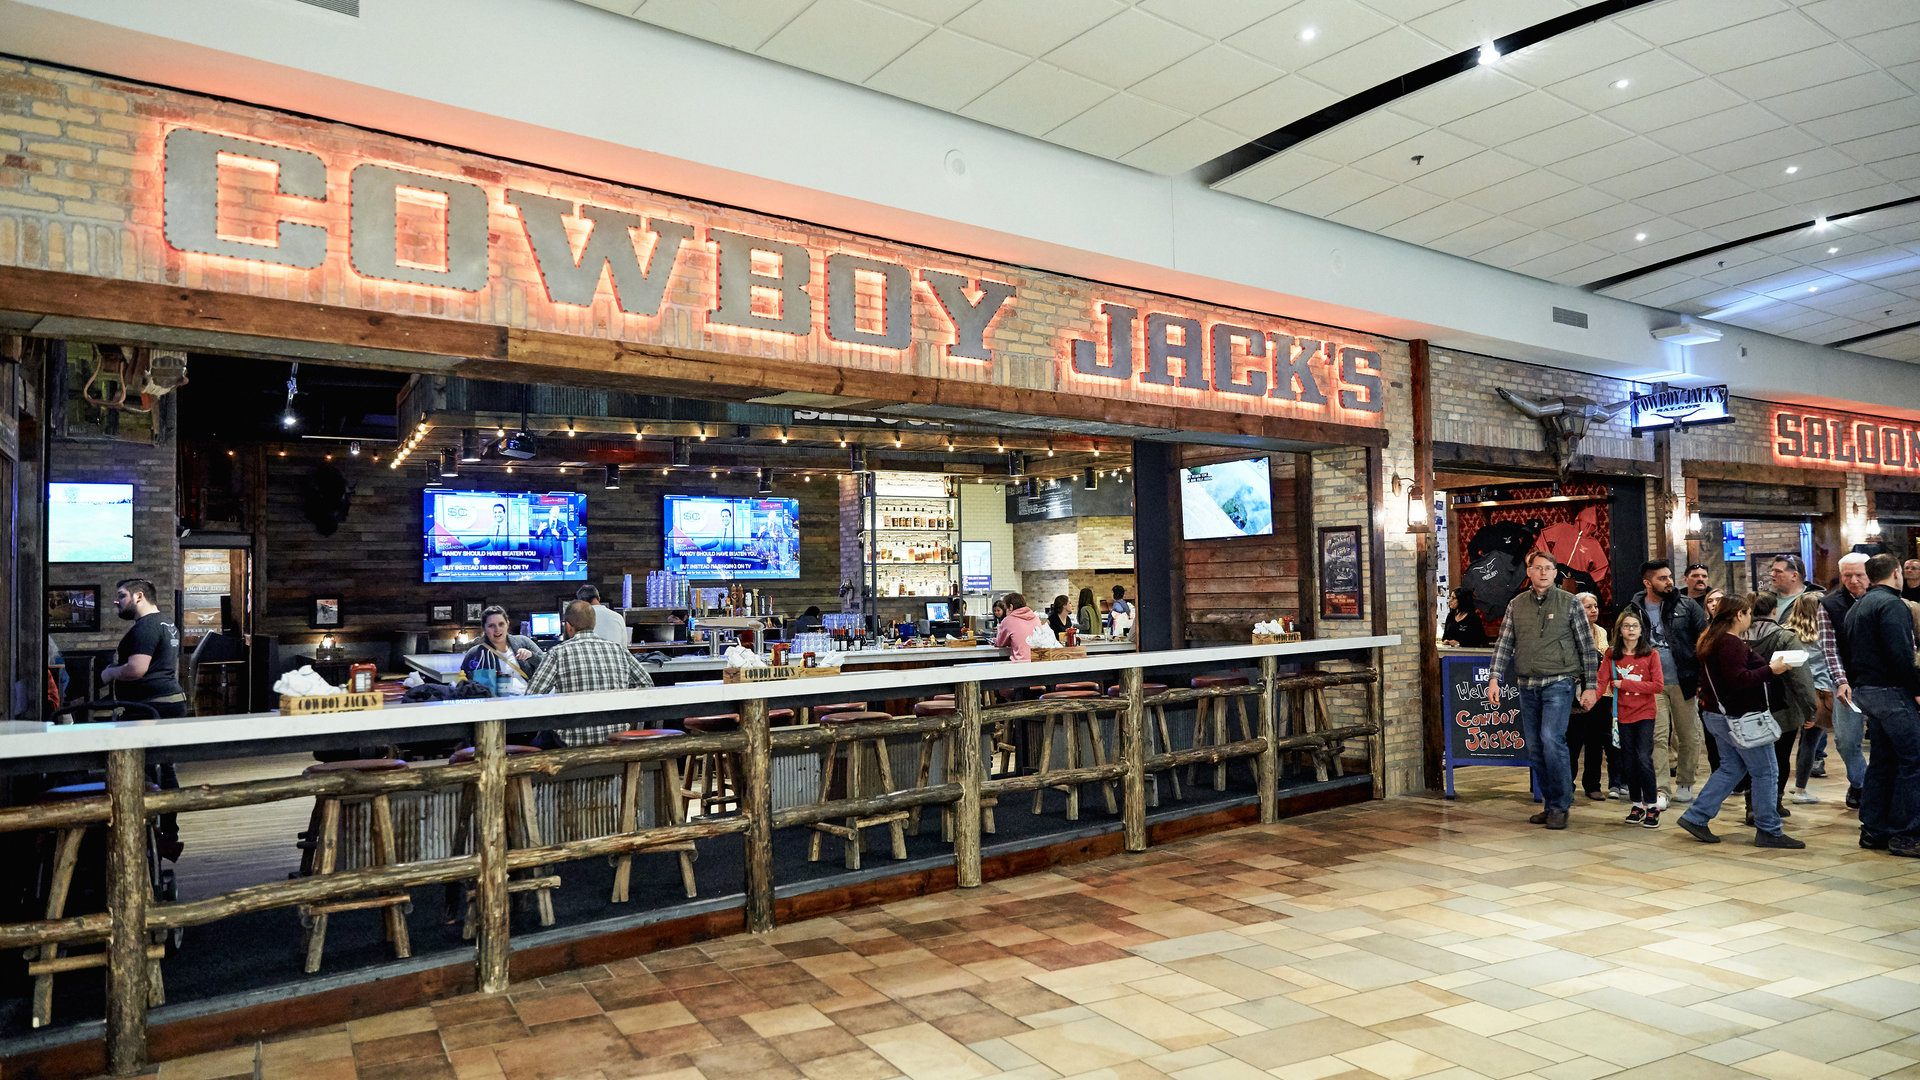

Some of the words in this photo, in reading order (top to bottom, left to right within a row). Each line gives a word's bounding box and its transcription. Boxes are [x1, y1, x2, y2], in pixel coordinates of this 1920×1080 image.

[164, 128, 1016, 361] COWBOY
[1071, 303, 1383, 412] JACK'S
[1634, 389, 1684, 414] COWBOY
[1683, 386, 1726, 404] JACK'S
[1656, 403, 1701, 413] SALOON
[744, 668, 772, 679] COWBOY
[298, 696, 340, 711] COWBOY
[343, 694, 378, 708] JACK'S
